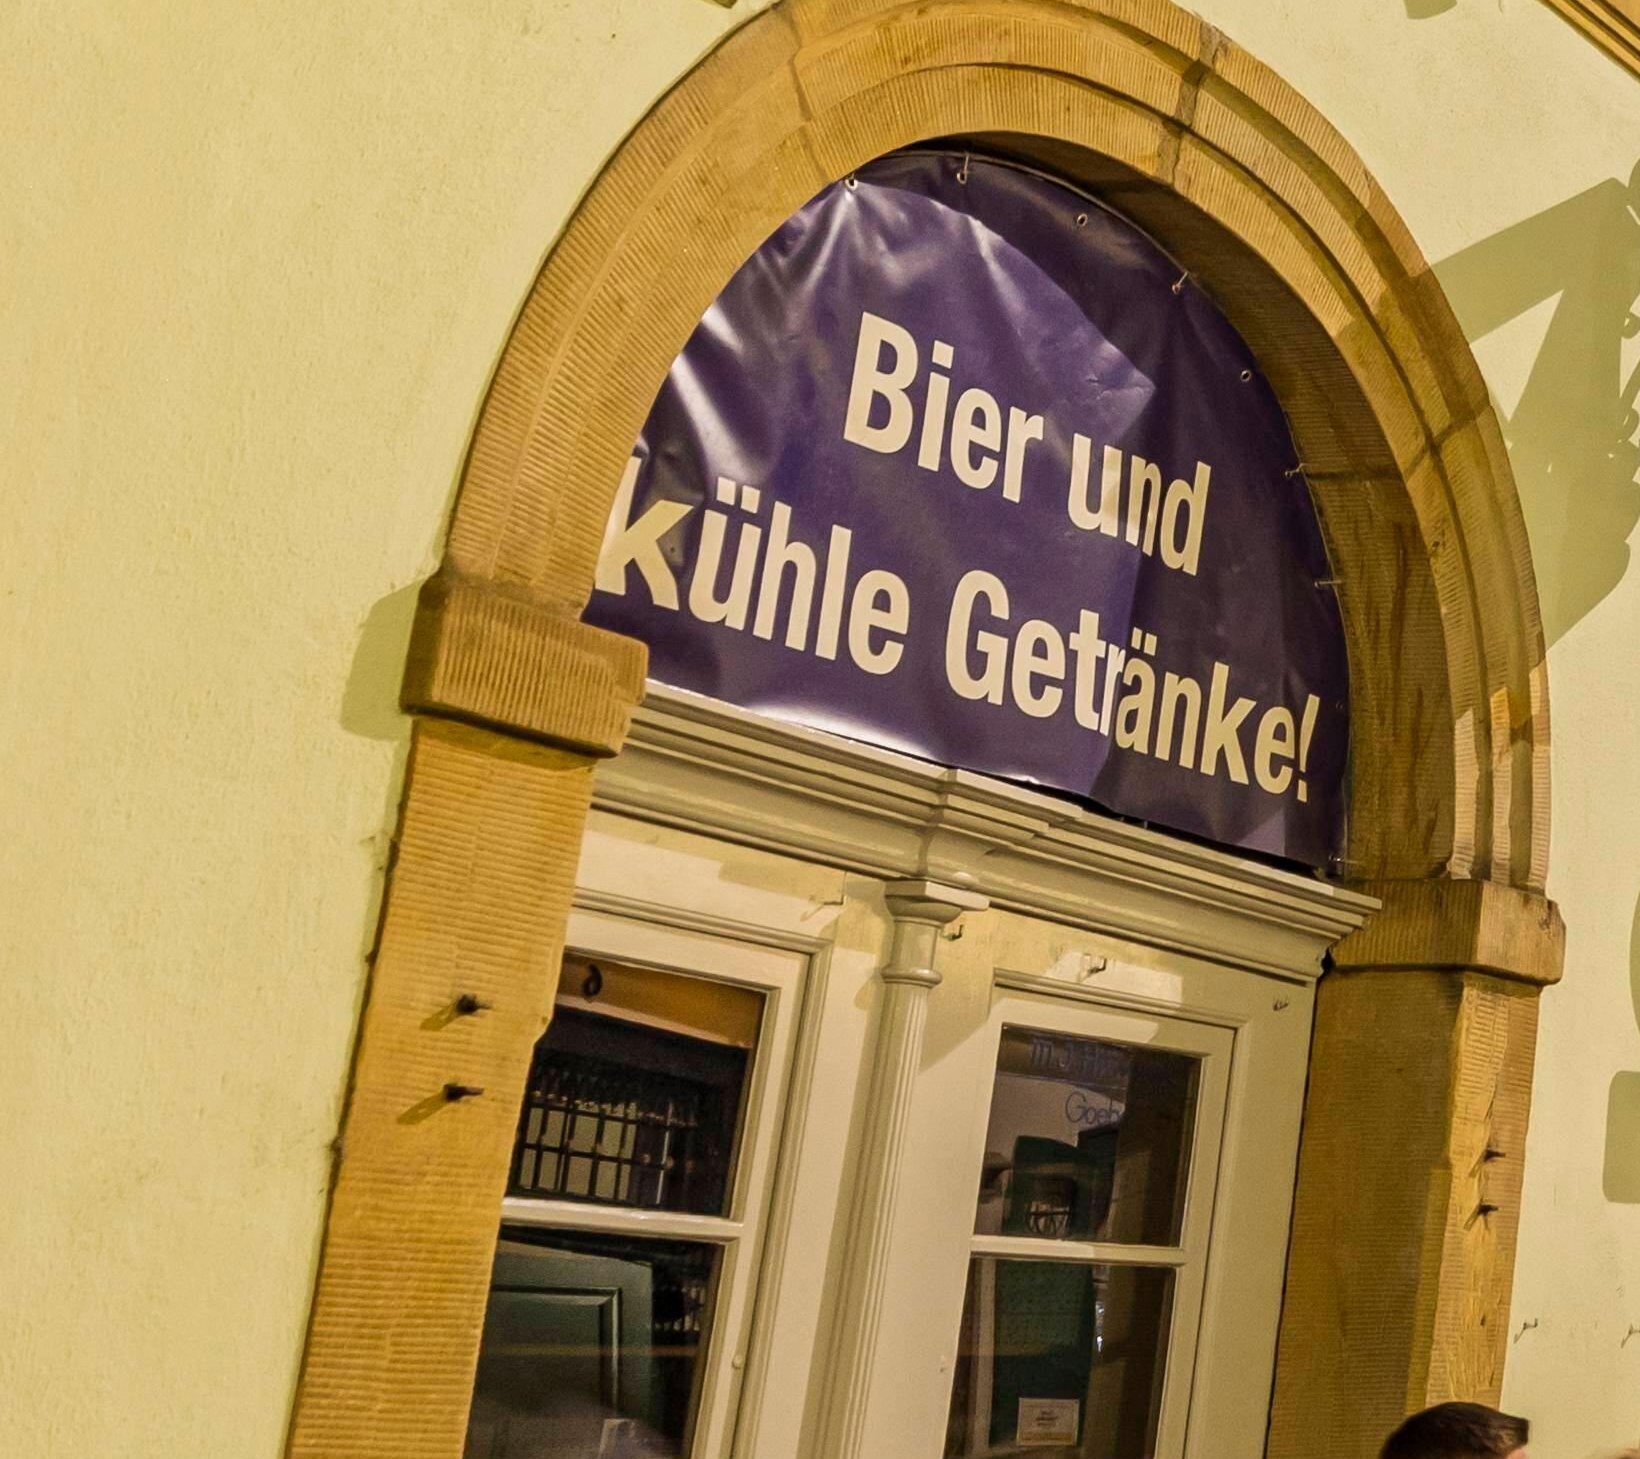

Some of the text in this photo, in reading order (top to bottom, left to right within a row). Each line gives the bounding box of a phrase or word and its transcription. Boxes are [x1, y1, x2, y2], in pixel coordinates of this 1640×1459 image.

[843, 312, 1211, 577] Bier und
[593, 456, 1322, 803] kühle Getränke!
